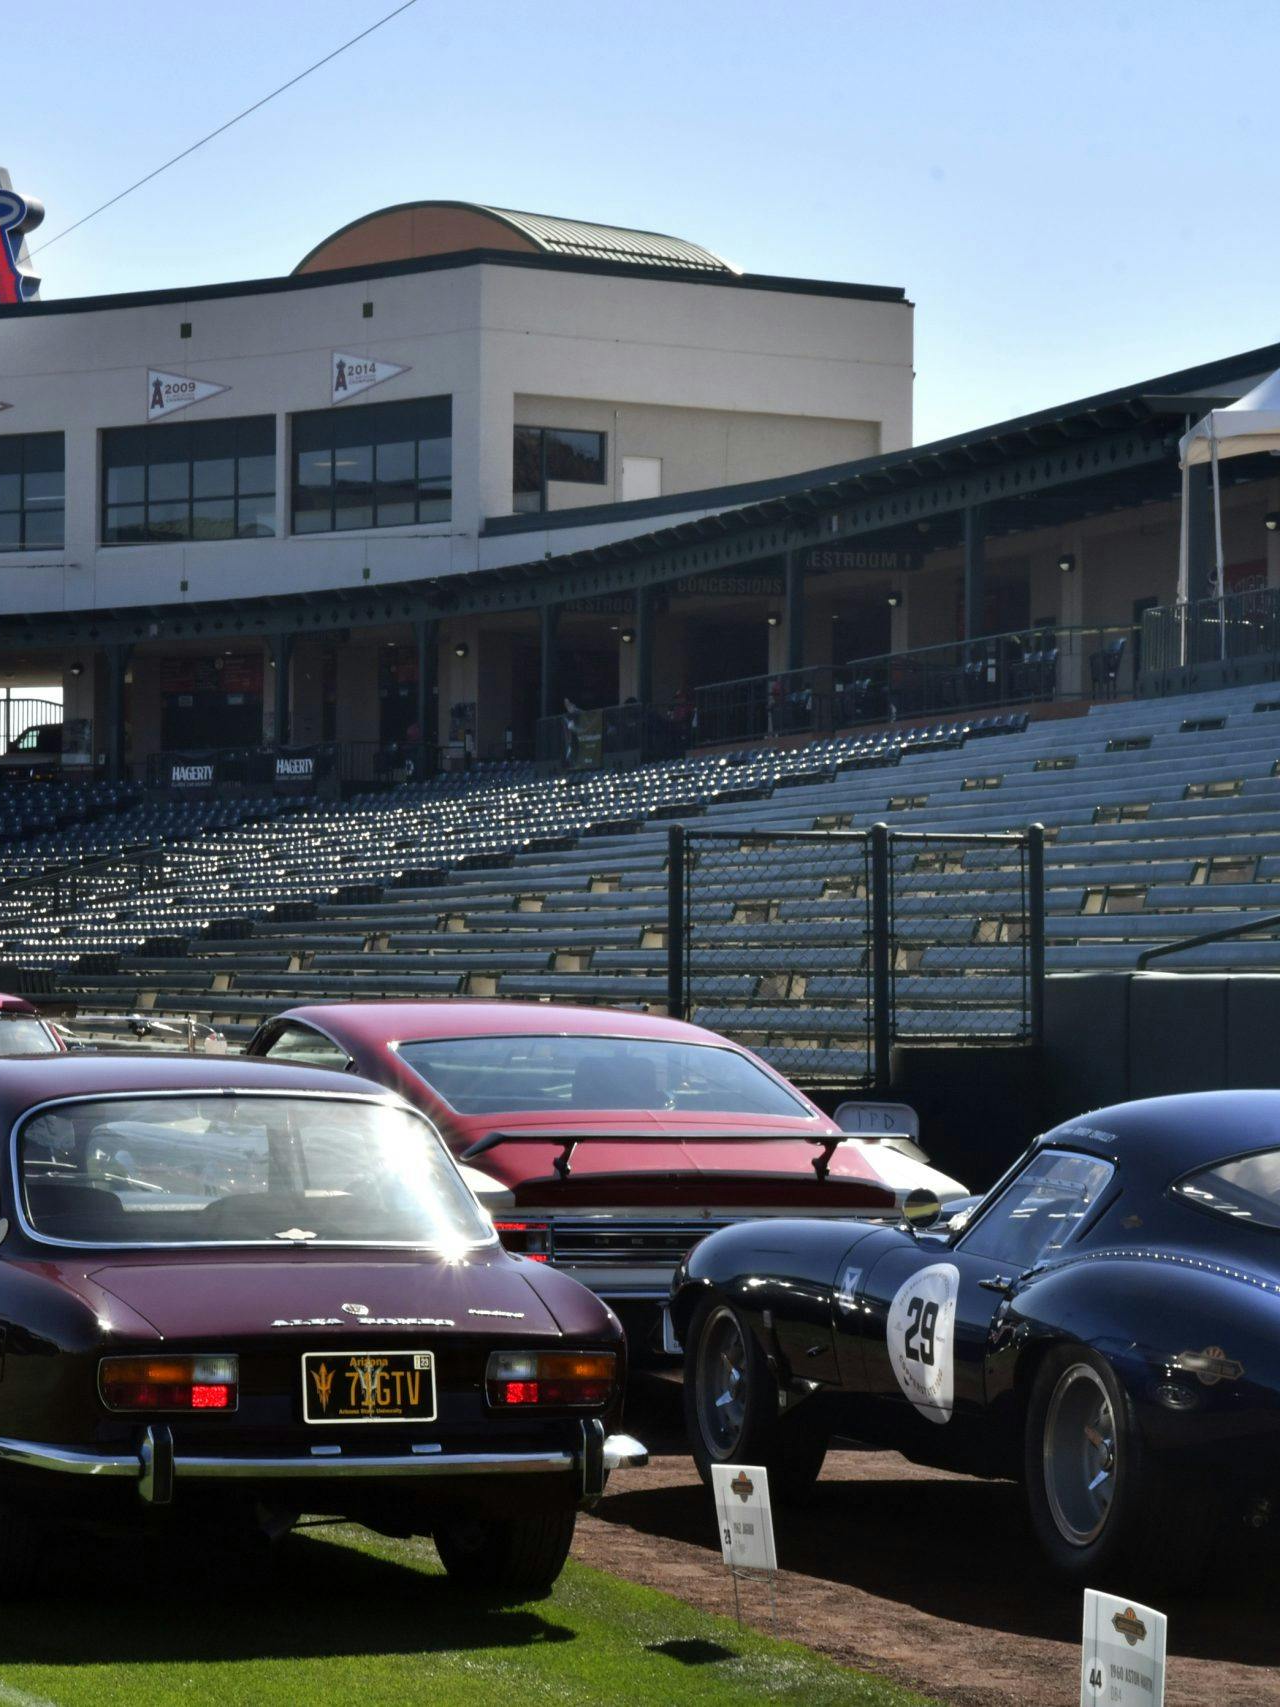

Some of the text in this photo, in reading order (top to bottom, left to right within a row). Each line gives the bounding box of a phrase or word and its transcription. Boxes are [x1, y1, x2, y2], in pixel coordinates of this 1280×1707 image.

[348, 363, 376, 376] 2014
[165, 383, 196, 394] 2009
[172, 766, 214, 780] HAGERTY
[276, 759, 313, 773] HAGERTY
[904, 1297, 939, 1367] 29
[1089, 1668, 1102, 1688] 44
